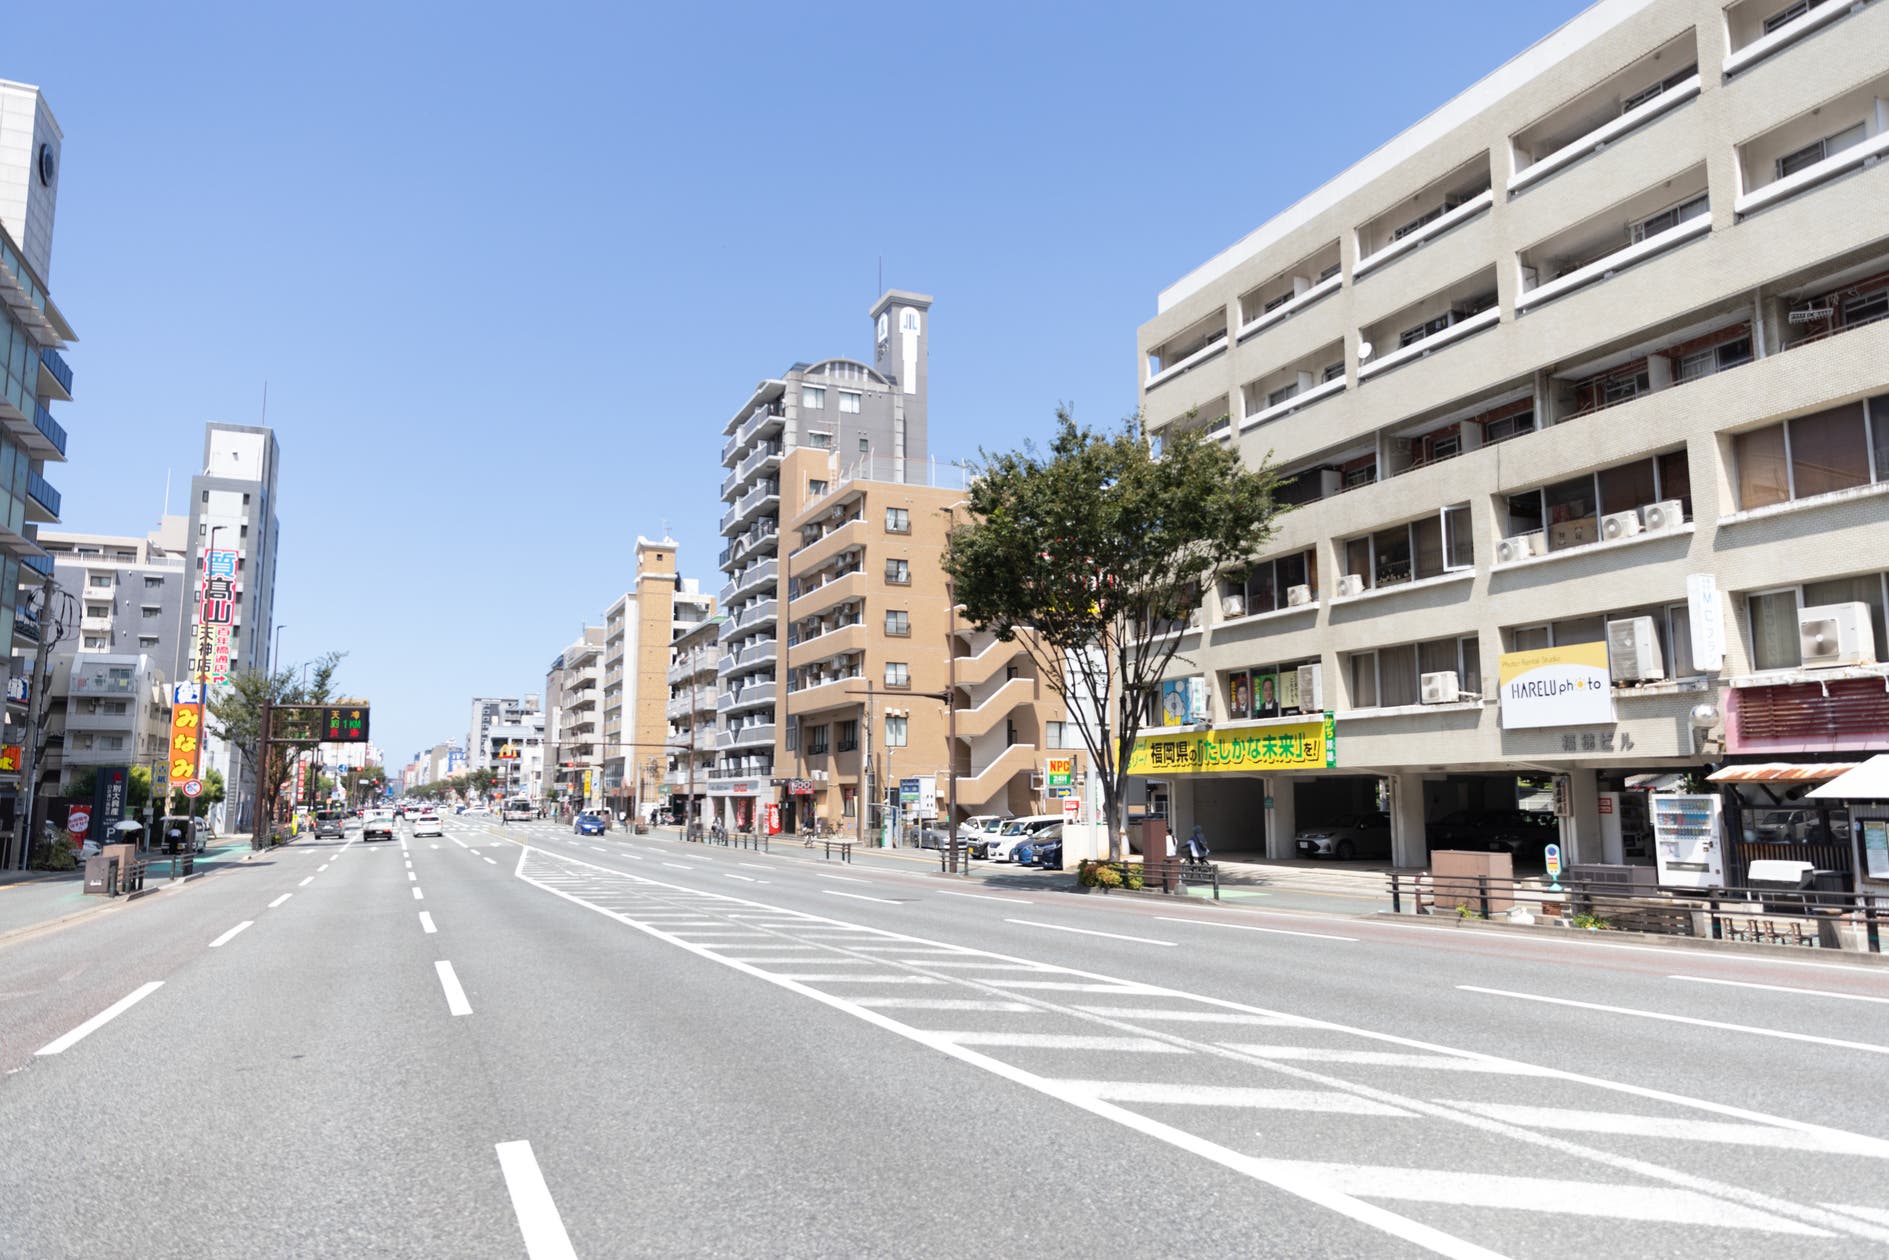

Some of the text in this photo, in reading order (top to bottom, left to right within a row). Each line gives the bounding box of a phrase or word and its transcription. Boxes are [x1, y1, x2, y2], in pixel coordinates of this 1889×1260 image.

[197, 626, 214, 672] 天神店
[1511, 680, 1557, 699] HARELU
[171, 708, 199, 779] みなみ
[1050, 760, 1070, 772] NPC
[1053, 775, 1067, 783] 24H
[106, 827, 116, 838] P
